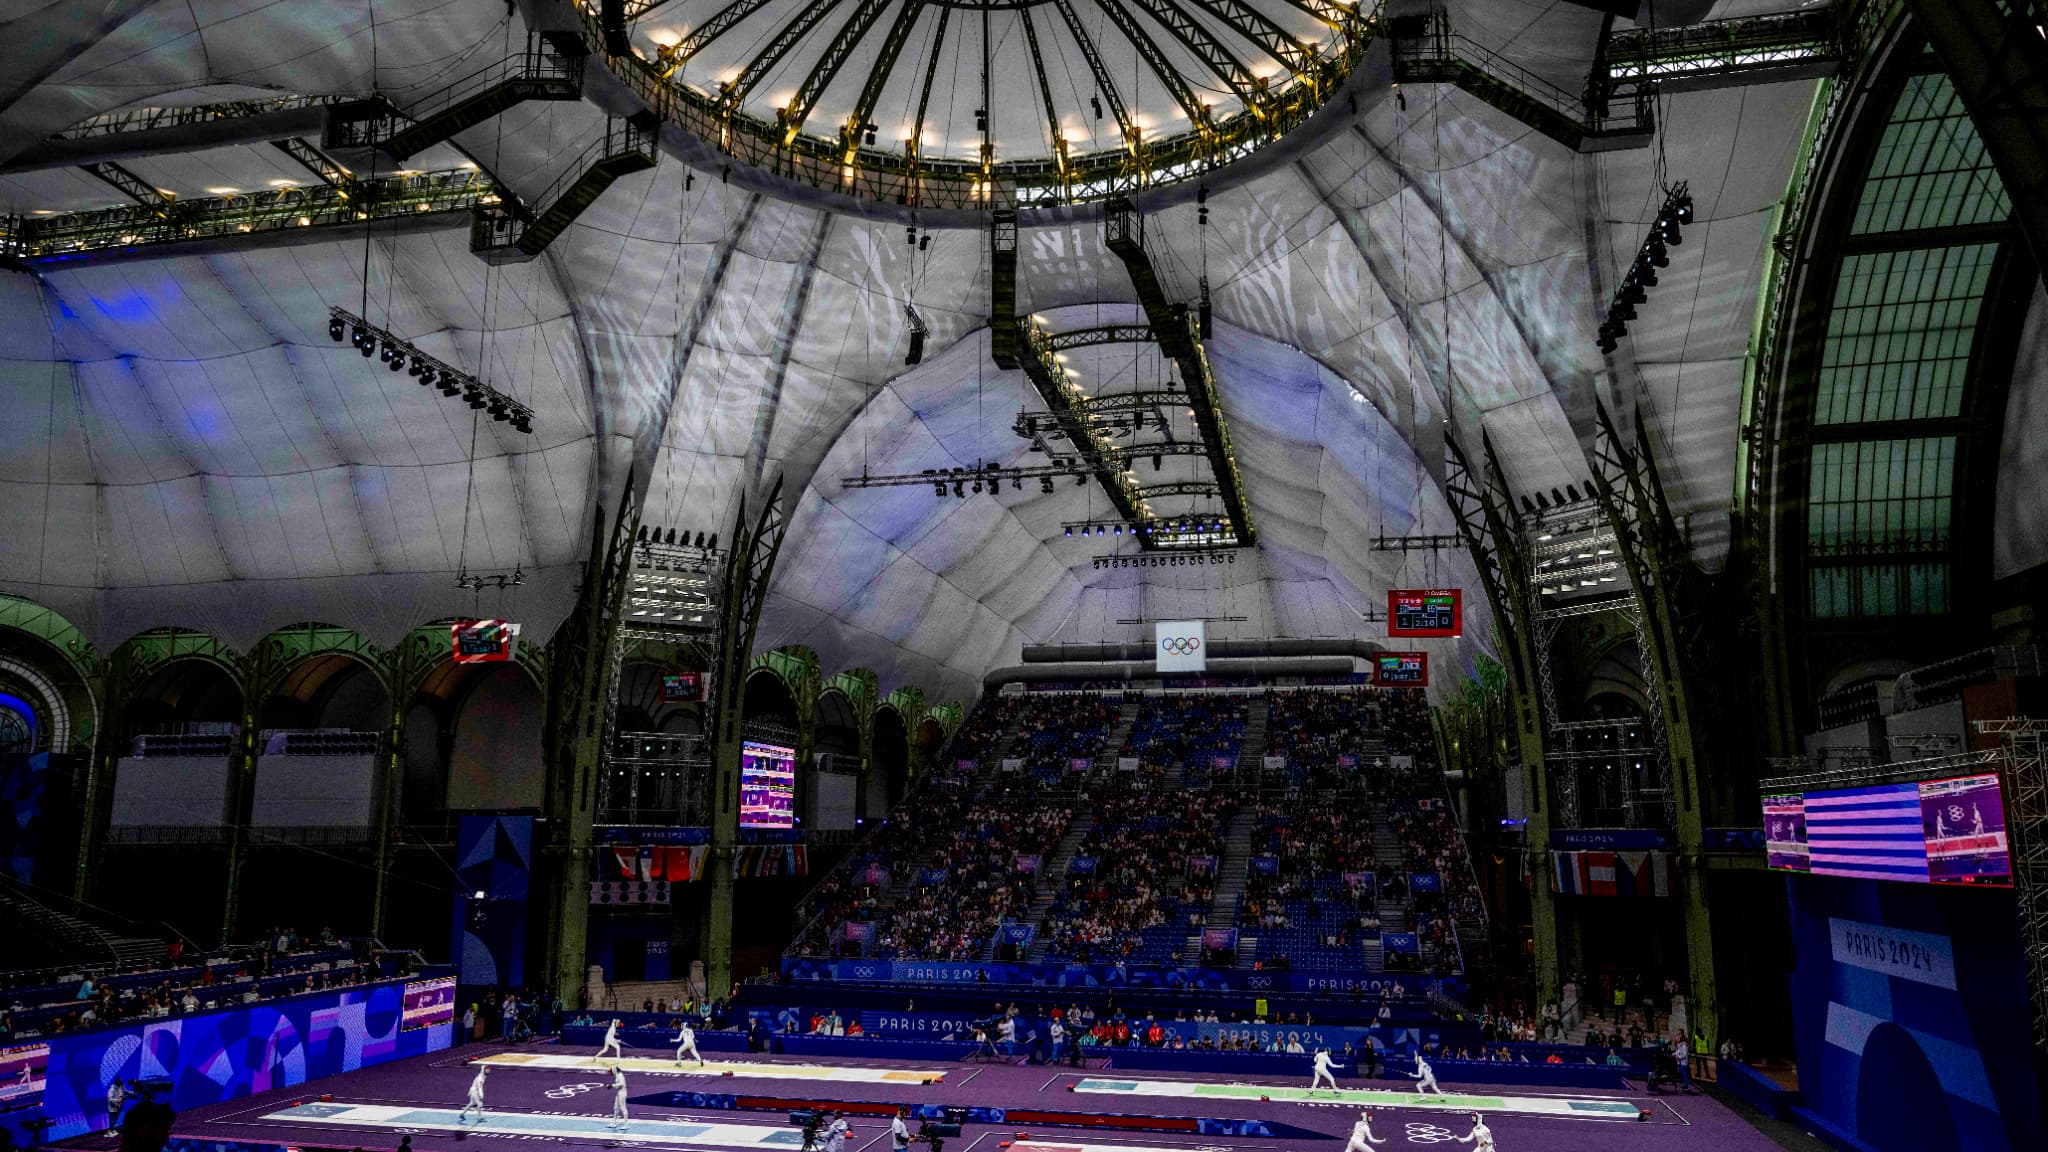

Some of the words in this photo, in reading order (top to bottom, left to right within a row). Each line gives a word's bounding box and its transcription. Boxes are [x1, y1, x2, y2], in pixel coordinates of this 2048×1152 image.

[1846, 931, 1886, 962] PARIS
[1889, 939, 1932, 972] 2024
[908, 968, 948, 980] PARIS
[1308, 978, 1354, 991] PARIS
[880, 1017, 925, 1031] PARIS
[931, 1019, 974, 1033] 2024
